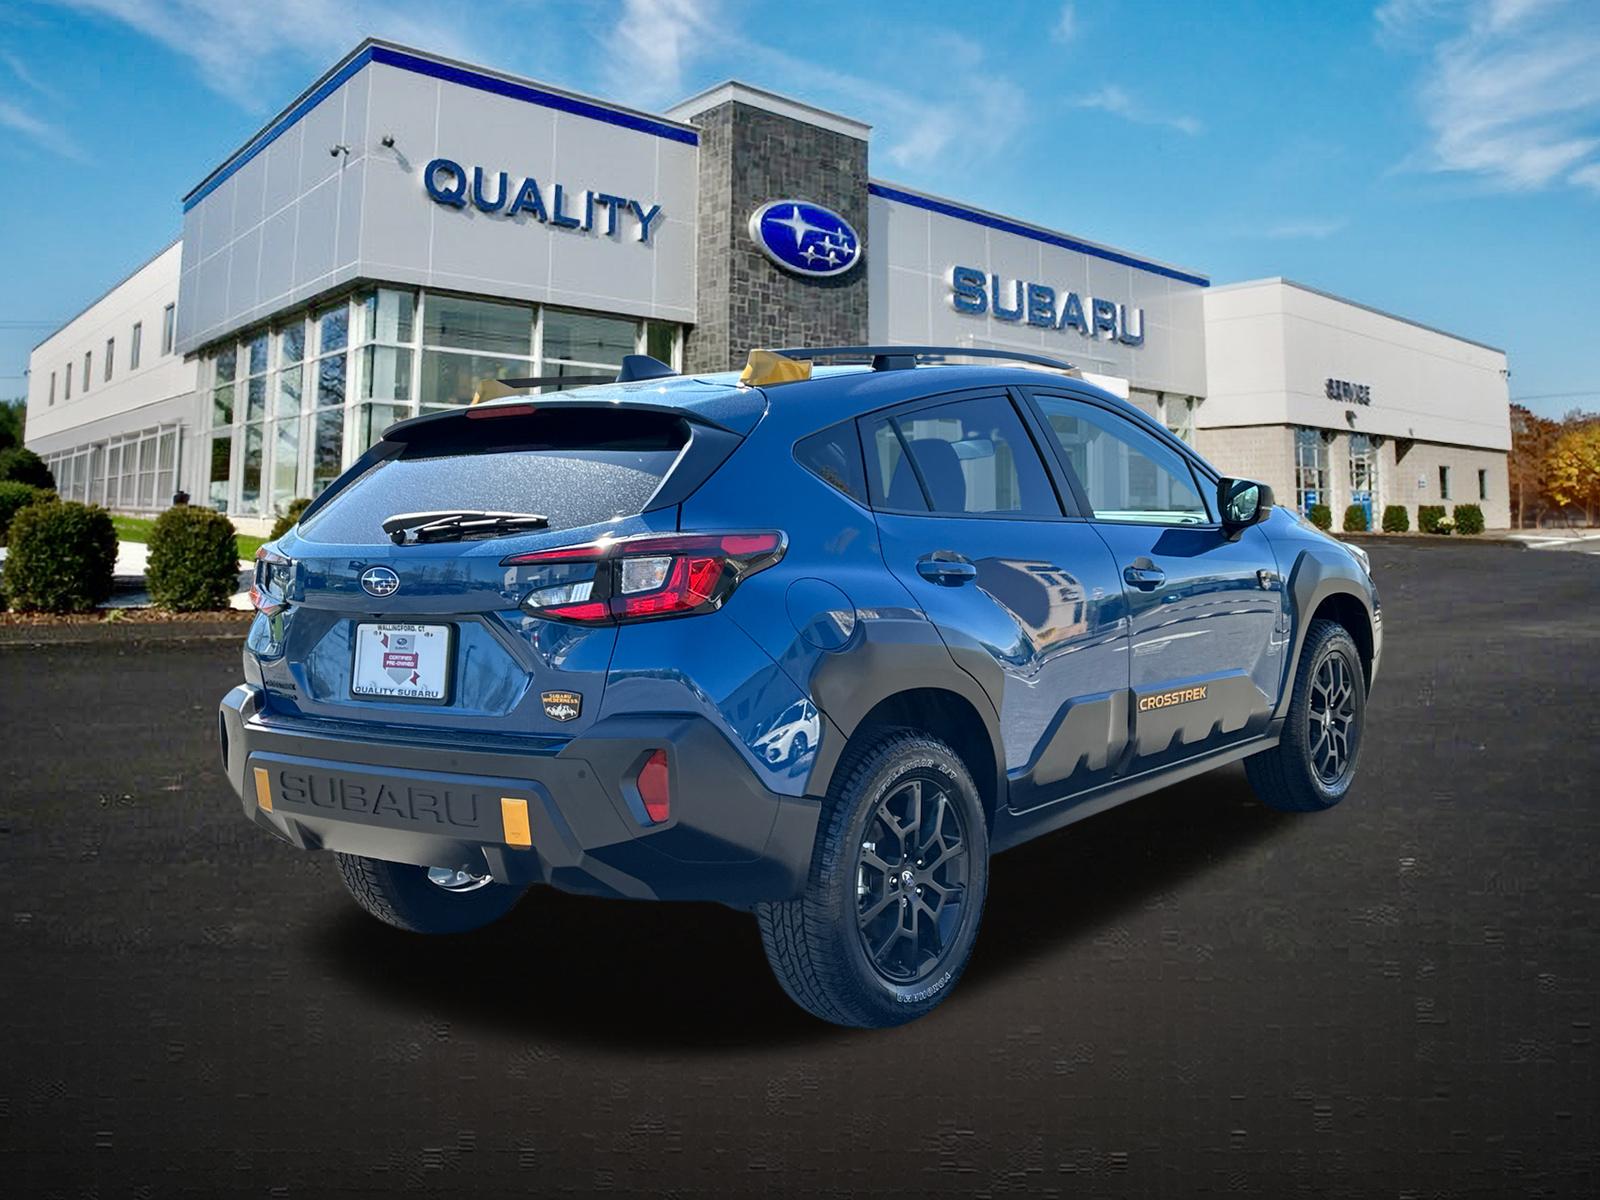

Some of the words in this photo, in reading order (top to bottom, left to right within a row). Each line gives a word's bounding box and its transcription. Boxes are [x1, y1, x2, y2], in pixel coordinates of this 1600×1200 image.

[424, 158, 662, 242] QUALITY
[948, 265, 1145, 347] SUBARU
[418, 625, 425, 633] CT
[355, 686, 395, 696] QUALITY
[397, 688, 439, 698] SUBARU
[1139, 686, 1207, 711] CROSSTREK
[280, 770, 480, 828] SUBARU
